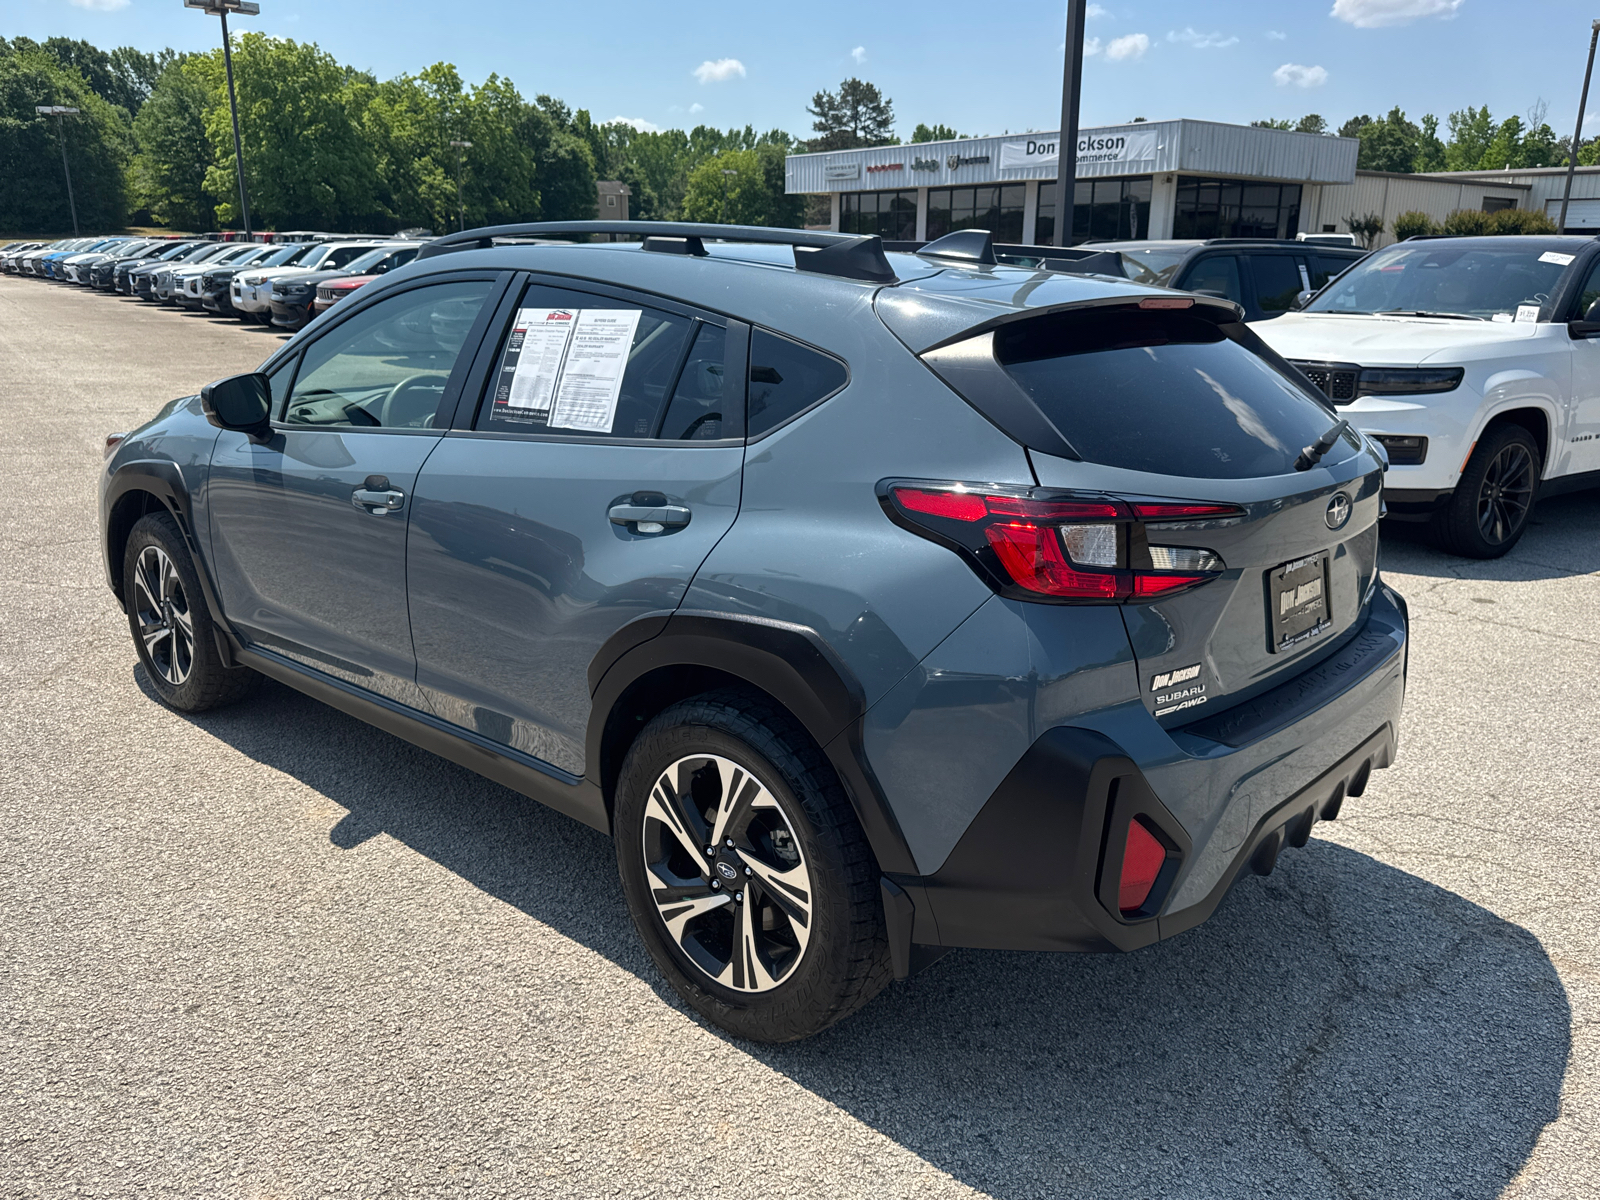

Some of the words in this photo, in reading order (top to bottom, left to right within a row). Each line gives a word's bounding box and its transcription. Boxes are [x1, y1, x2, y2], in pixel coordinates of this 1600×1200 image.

[1026, 140, 1055, 156] Don
[1077, 136, 1125, 152] ckson
[911, 156, 940, 173] Jeep
[1075, 153, 1119, 163] ommerce
[1294, 577, 1322, 607] JACKSON
[1152, 673, 1171, 691] DON
[1168, 664, 1201, 687] JACKSON
[1155, 684, 1206, 705] SUBARU
[1176, 695, 1208, 711] AWD
